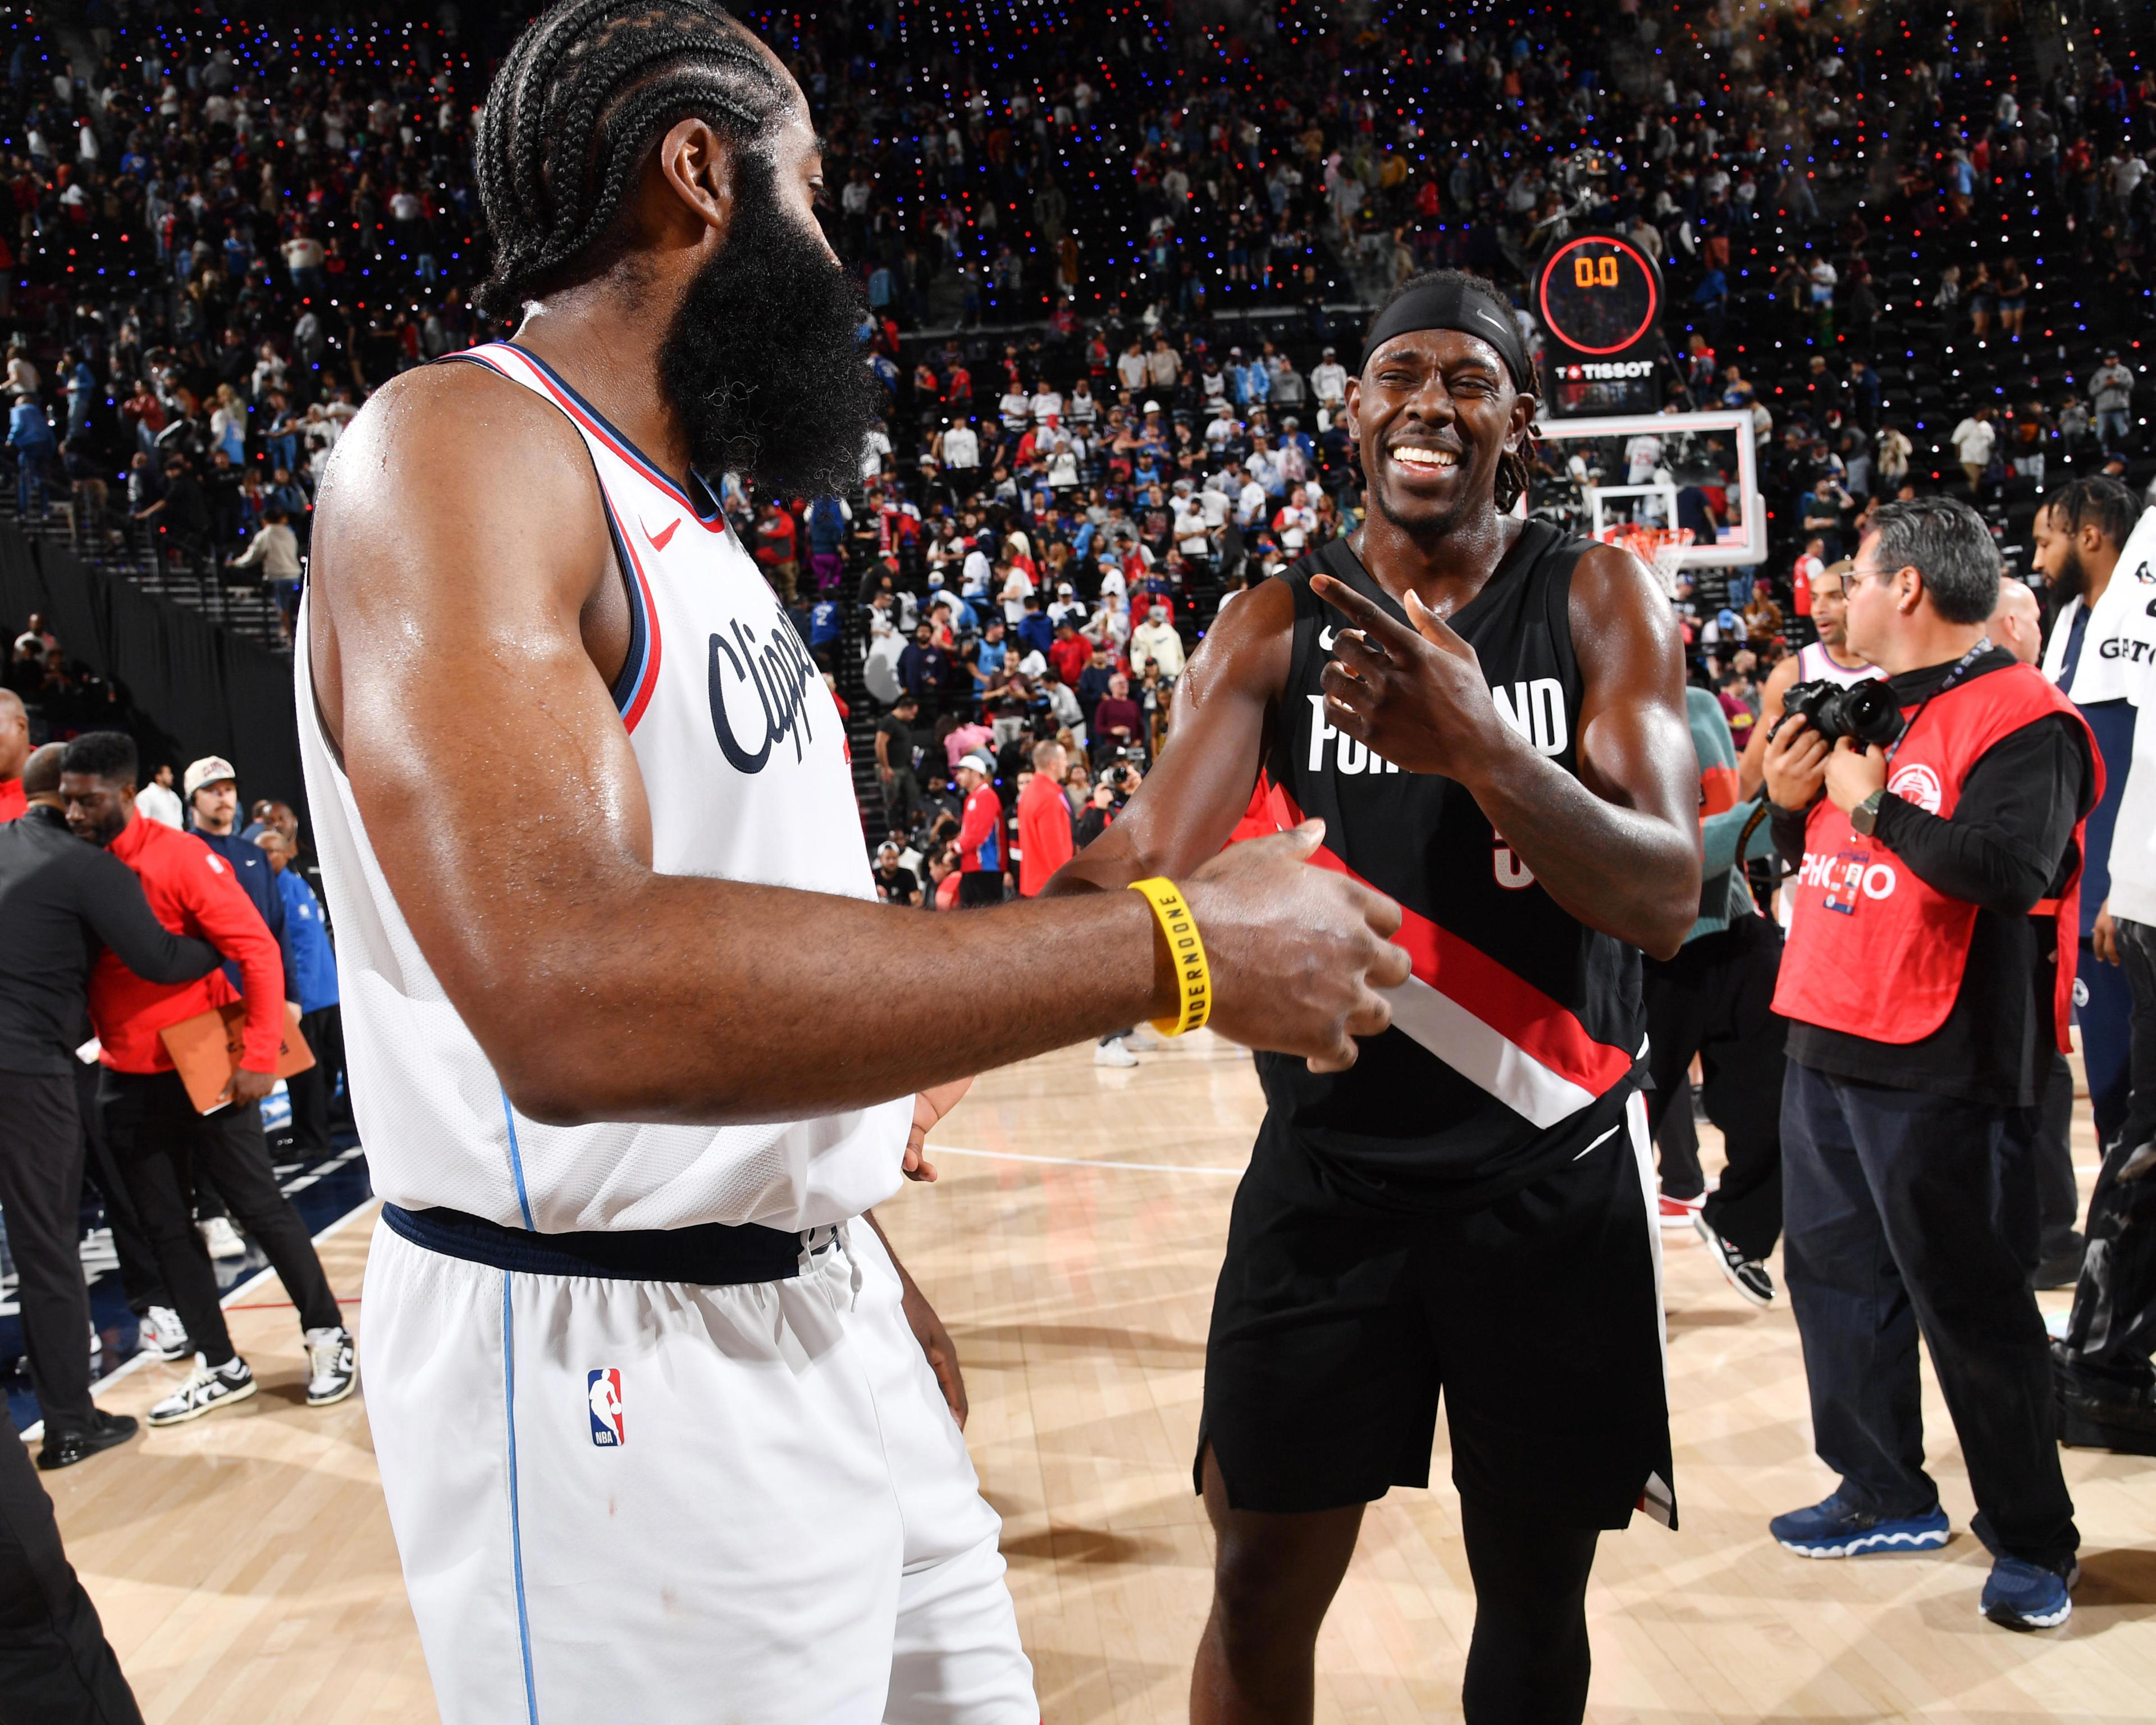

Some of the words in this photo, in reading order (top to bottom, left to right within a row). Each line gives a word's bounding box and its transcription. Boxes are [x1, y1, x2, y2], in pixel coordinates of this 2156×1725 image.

[1574, 256, 1619, 288] 0.0
[1581, 360, 1654, 380] TISSOT
[595, 1431, 613, 1444] NBA
